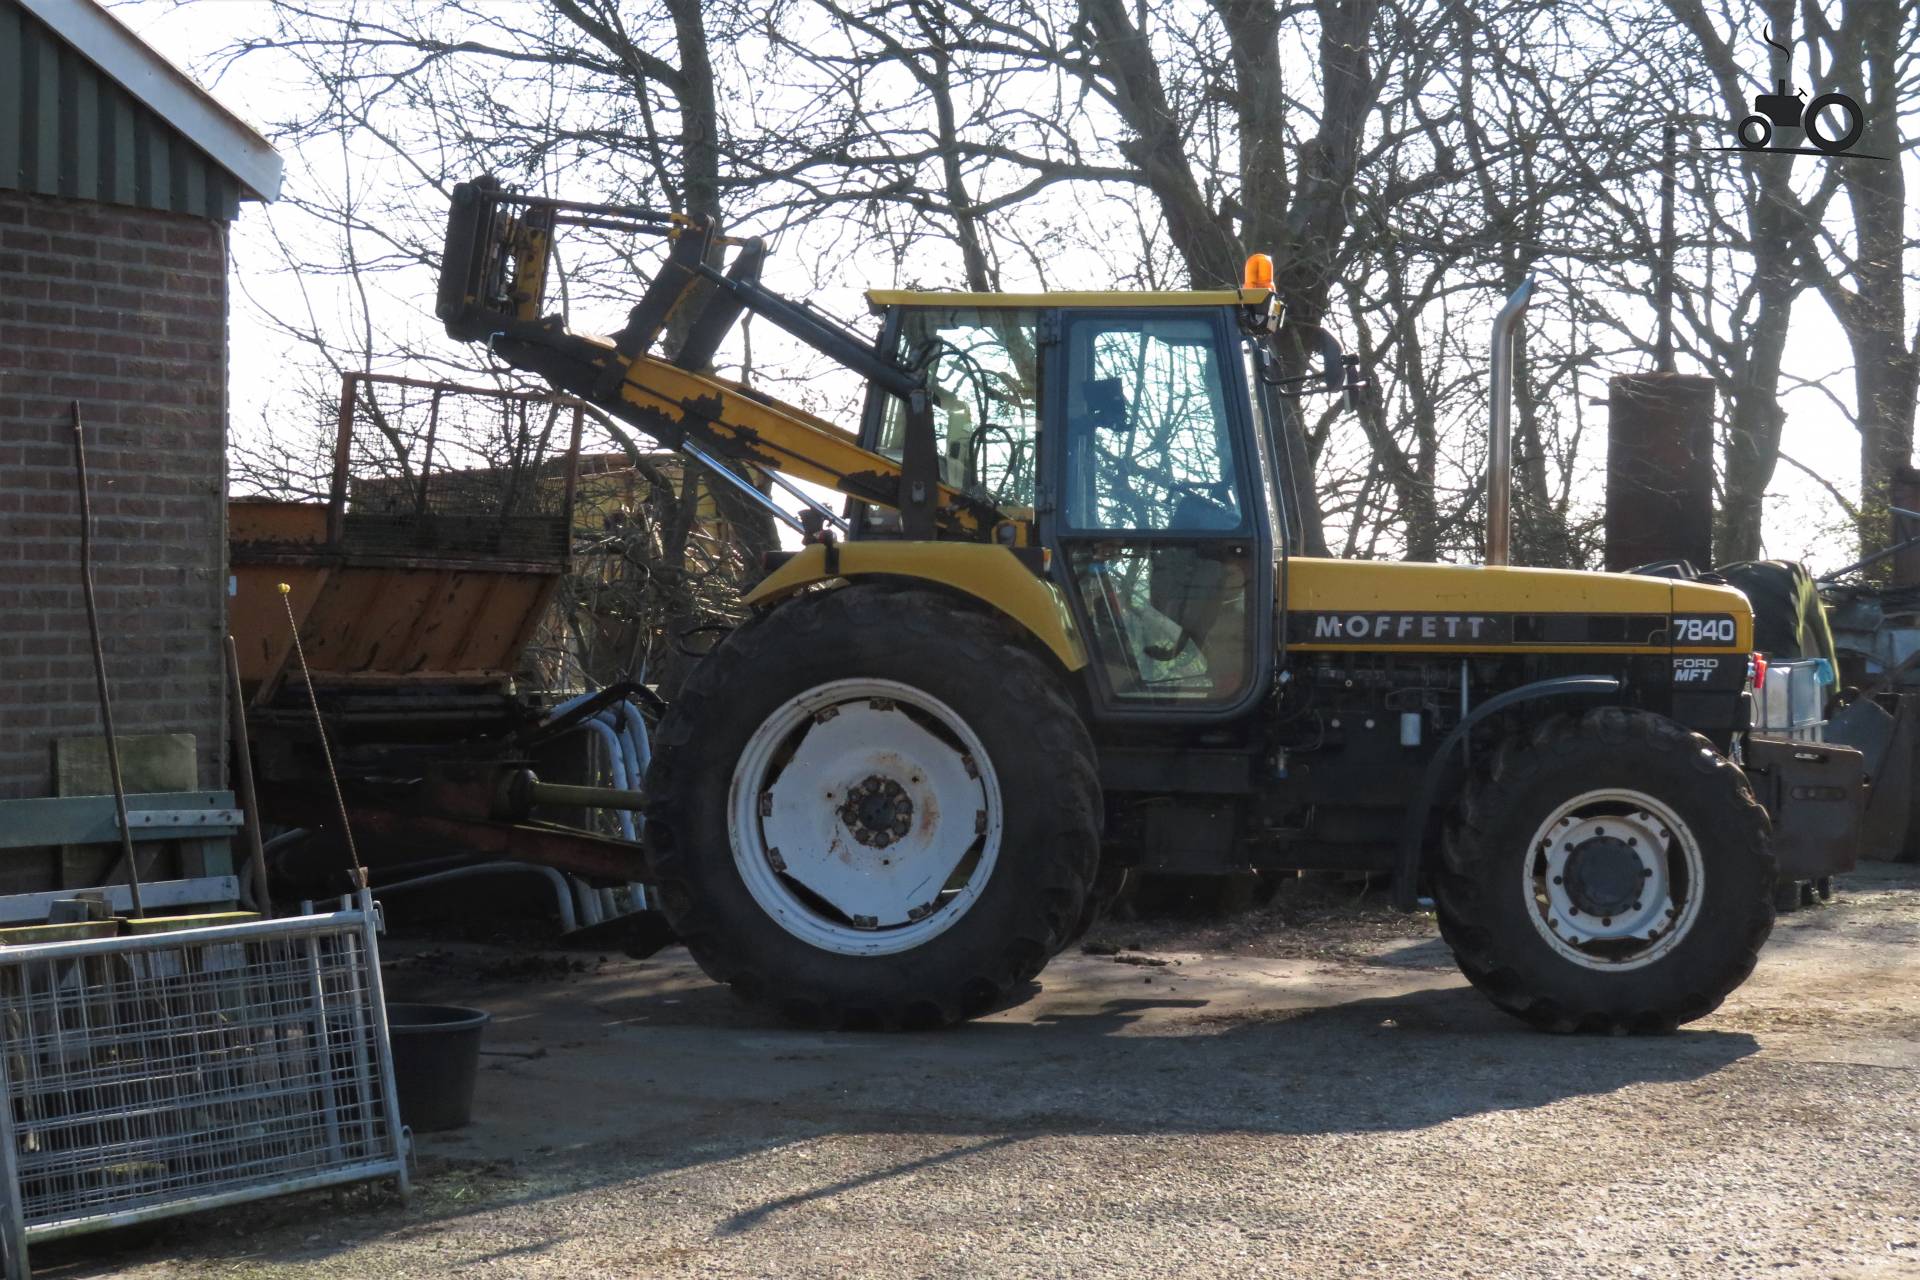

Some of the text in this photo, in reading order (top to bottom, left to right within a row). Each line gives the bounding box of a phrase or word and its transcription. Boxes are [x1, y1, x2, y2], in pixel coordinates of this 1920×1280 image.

[1315, 615, 1485, 638] MOFFETT
[1673, 619, 1734, 641] 7840
[1673, 658, 1719, 668] FORD
[1674, 669, 1712, 681] MFT
